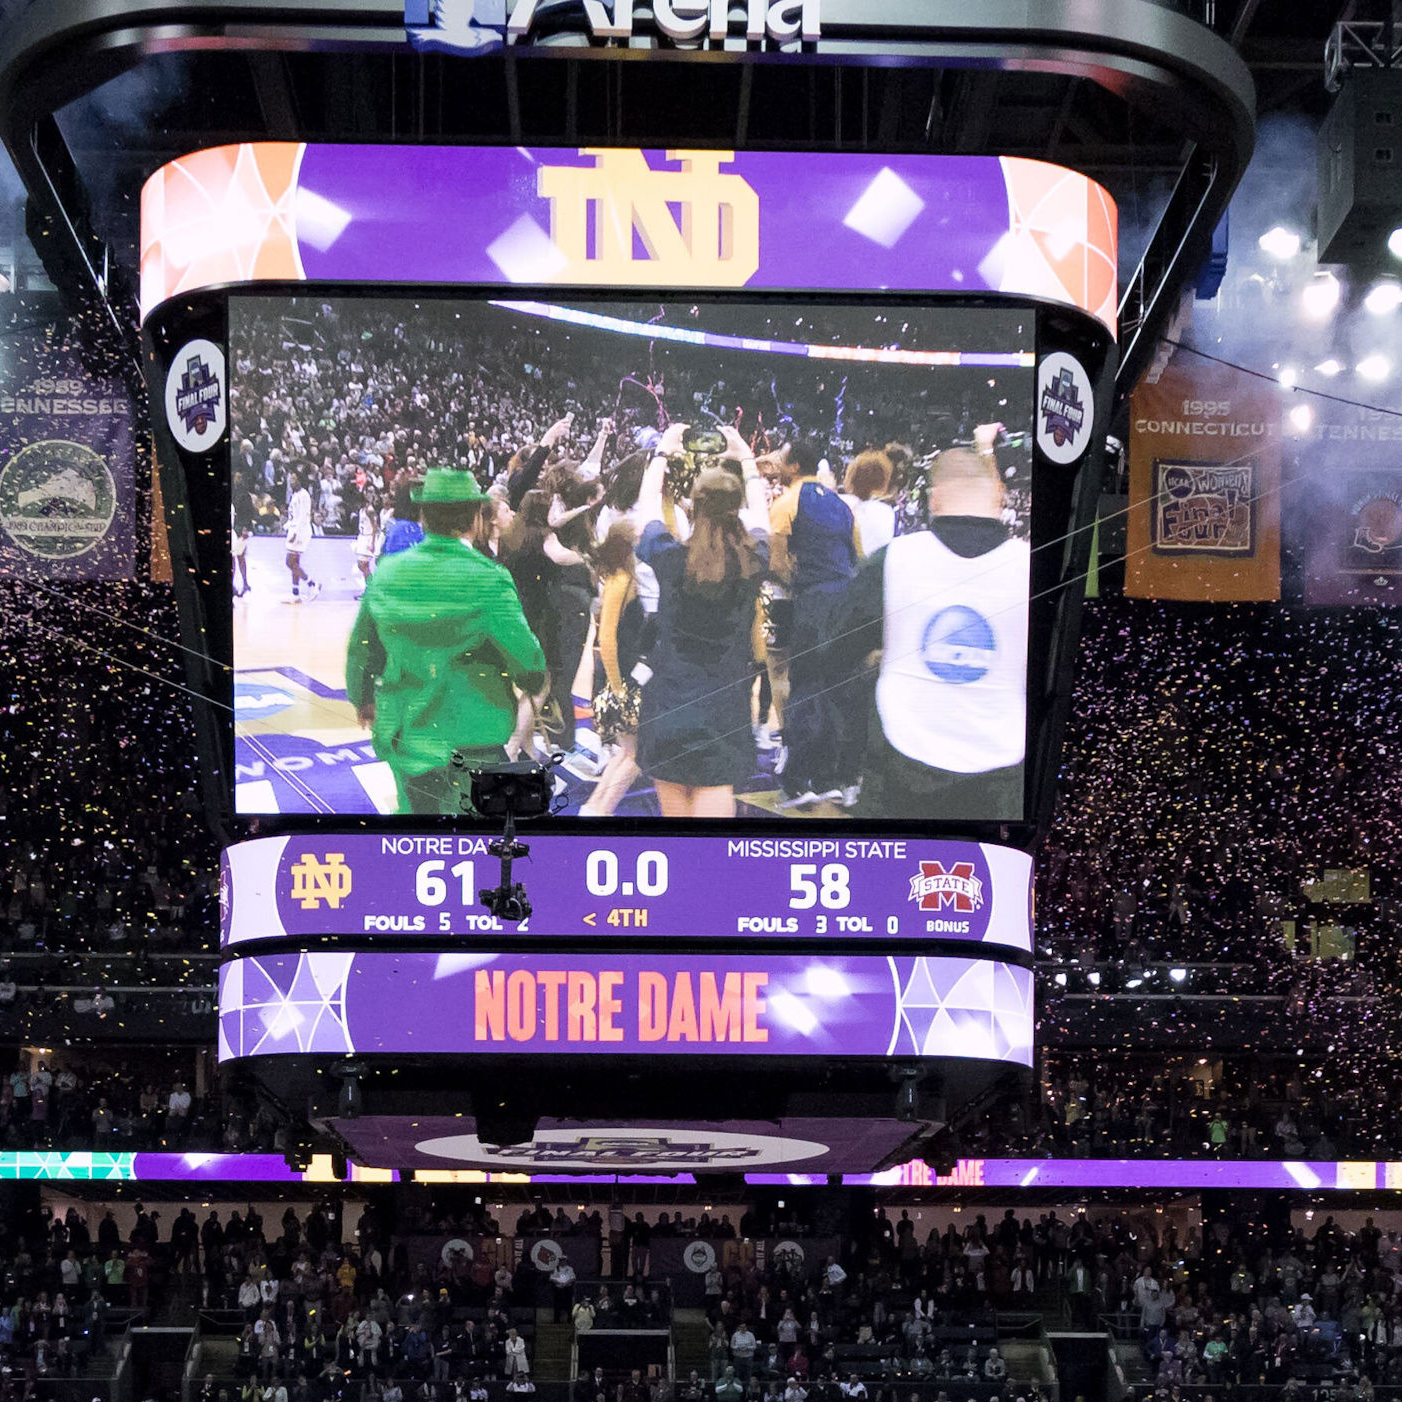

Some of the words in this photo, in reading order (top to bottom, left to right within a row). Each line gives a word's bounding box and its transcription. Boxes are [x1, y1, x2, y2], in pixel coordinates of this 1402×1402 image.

[178, 391, 197, 411] FINAL
[1042, 395, 1064, 416] FINAL
[1135, 420, 1274, 437] CONNECTICUT
[382, 838, 452, 855] NOTRE
[458, 838, 519, 855] DA
[728, 840, 839, 858] MISSISSIPPI
[845, 841, 907, 859] STATE
[415, 859, 475, 906] 61
[586, 849, 669, 898] 0.0
[788, 863, 851, 910] 58
[924, 876, 971, 893] STATE
[364, 914, 426, 932] FOULS
[439, 912, 451, 930] 5
[466, 914, 503, 932] TOL
[737, 917, 798, 933] FOULS
[815, 915, 828, 934] 3
[836, 916, 873, 933] TOL
[886, 916, 899, 935] 0
[926, 919, 970, 934] BONUS
[475, 968, 624, 1043] NOTRE
[638, 970, 769, 1044] DAME
[497, 1147, 619, 1159] FINAL
[630, 1147, 751, 1160] FOUR
